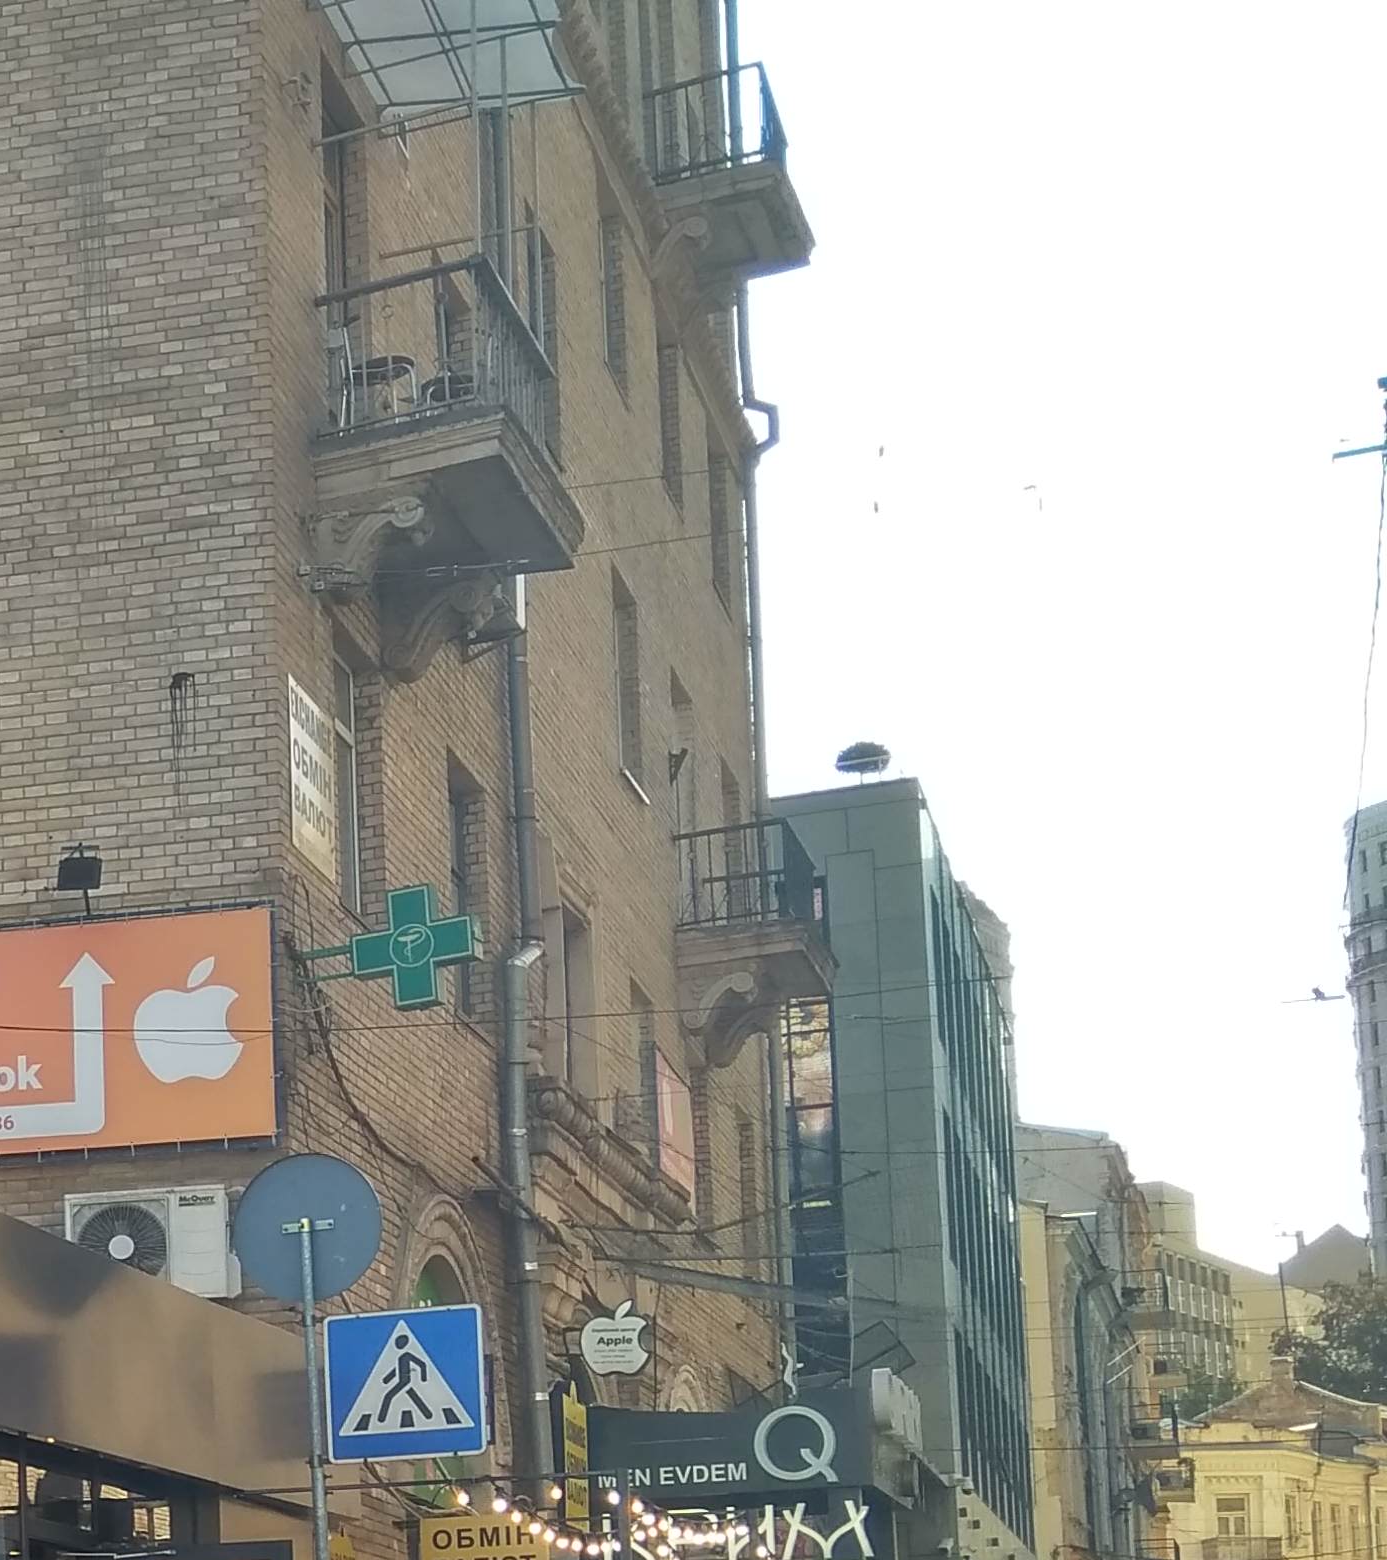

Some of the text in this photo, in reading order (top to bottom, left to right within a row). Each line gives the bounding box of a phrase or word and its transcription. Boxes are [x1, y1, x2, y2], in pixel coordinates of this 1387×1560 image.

[293, 737, 332, 802] ОБМІН
[293, 783, 333, 845] ВАЛЮТ
[596, 1335, 634, 1347] Apple
[753, 1405, 840, 1483] Q
[659, 1462, 747, 1485] EVDEM
[431, 1525, 535, 1551] ОБМІН
